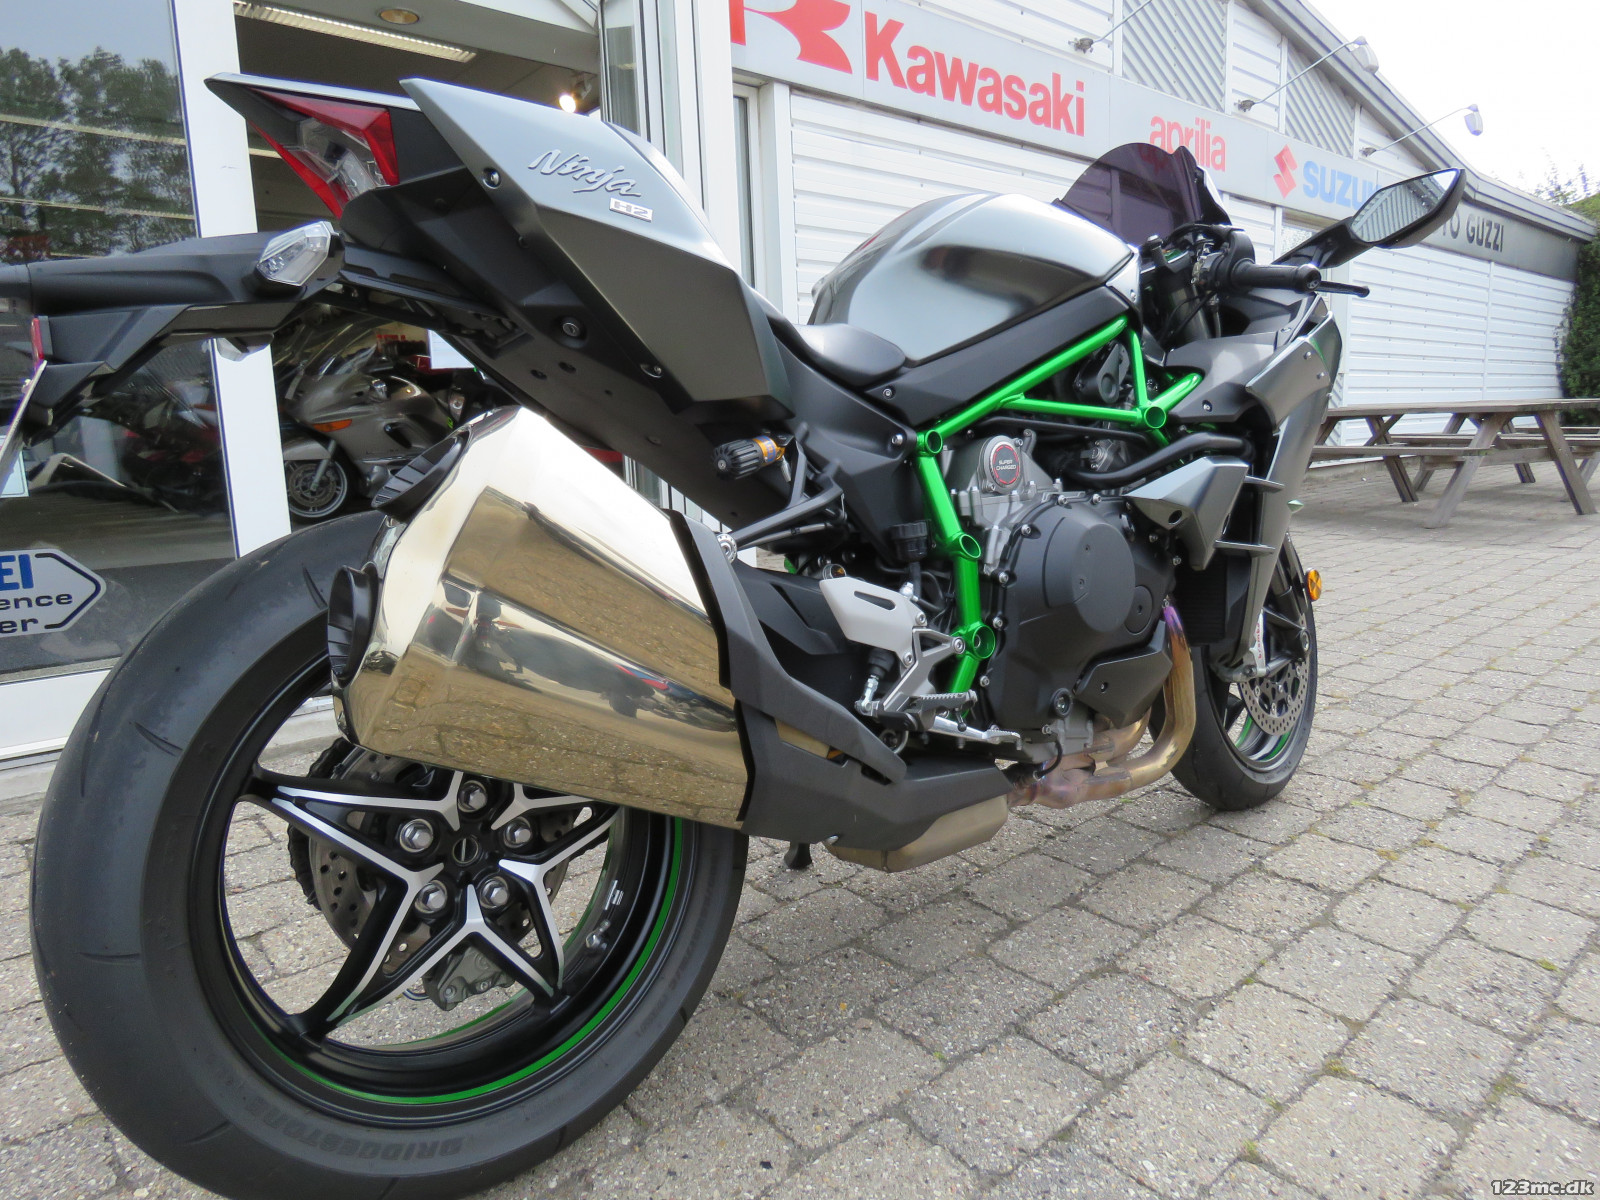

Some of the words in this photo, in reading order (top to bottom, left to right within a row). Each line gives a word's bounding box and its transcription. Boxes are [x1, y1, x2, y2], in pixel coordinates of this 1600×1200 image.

[864, 11, 1085, 137] Kawasaki
[1149, 115, 1226, 173] aprilia
[528, 149, 641, 197] Ninja
[611, 199, 650, 219] H2
[1466, 213, 1504, 253] GUZZI
[0, 593, 73, 610] ence
[0, 618, 39, 633] er
